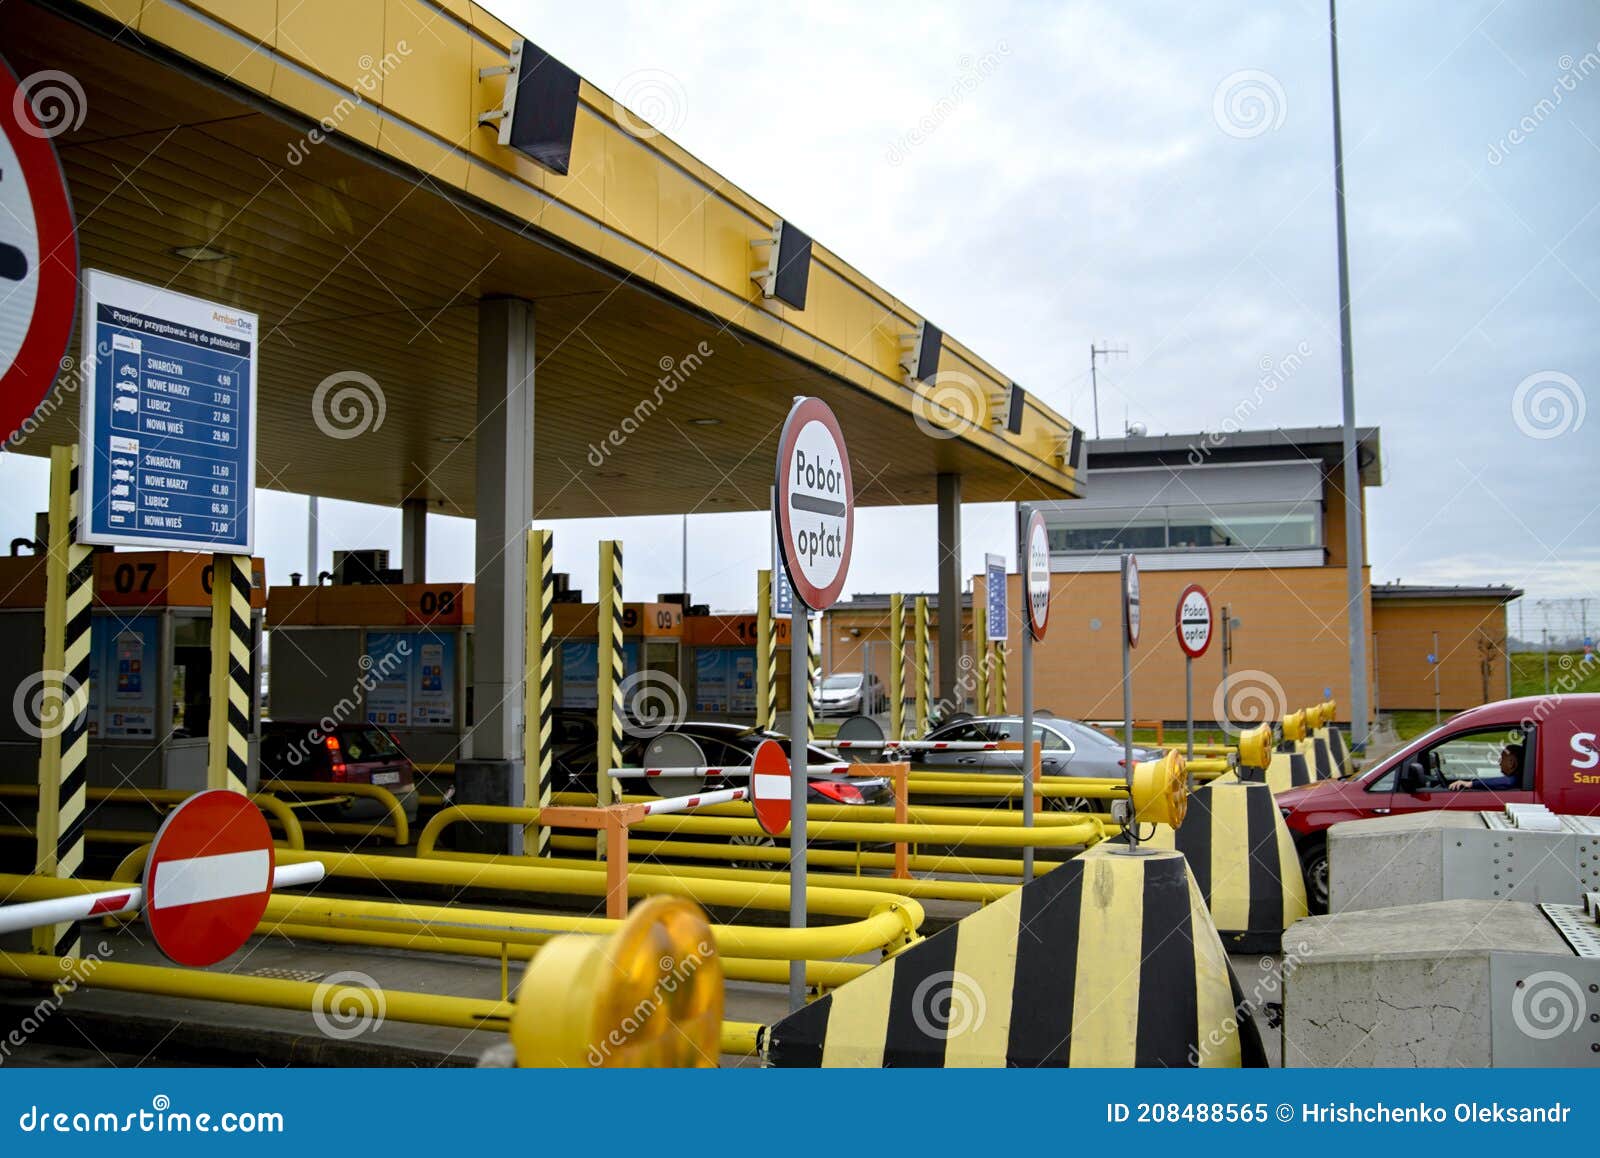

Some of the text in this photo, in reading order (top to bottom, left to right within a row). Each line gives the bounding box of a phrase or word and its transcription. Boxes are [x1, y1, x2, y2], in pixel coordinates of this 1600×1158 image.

[113, 310, 143, 329] Prosimy
[188, 330, 199, 342] się
[199, 333, 209, 344] do
[147, 378, 167, 392] NOWE
[168, 382, 190, 396] MARZY
[146, 418, 166, 432] NOWA
[796, 449, 841, 495] Pobór
[145, 475, 165, 488] NOWE
[166, 477, 189, 491] MARZY
[144, 516, 164, 528] NOWA
[798, 521, 842, 567] opłat
[114, 563, 157, 594] 07
[202, 564, 213, 595] 0
[420, 591, 456, 615] 08
[623, 608, 638, 629] 9
[657, 610, 672, 630] 09
[738, 622, 758, 639] 10
